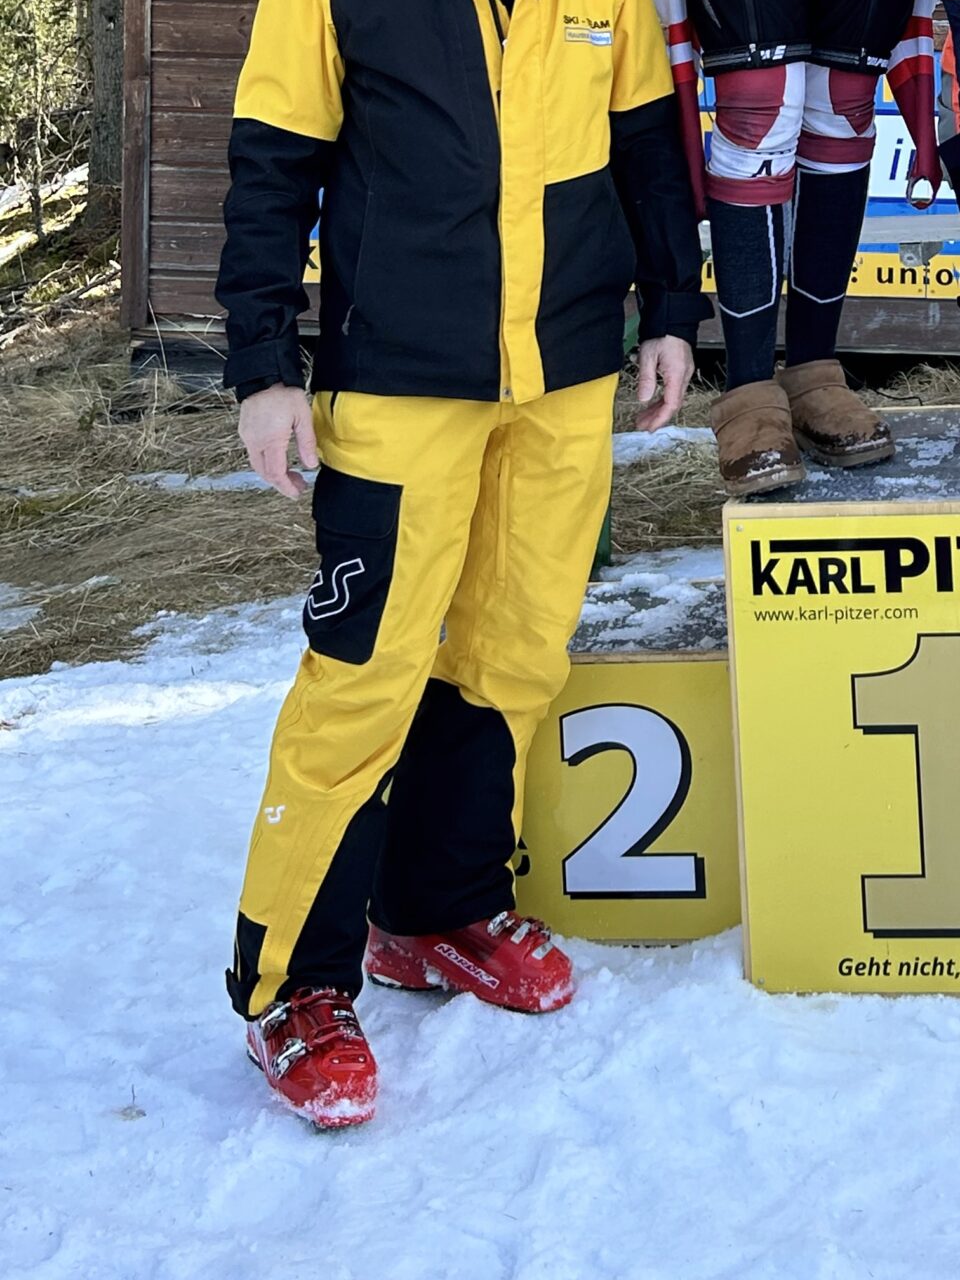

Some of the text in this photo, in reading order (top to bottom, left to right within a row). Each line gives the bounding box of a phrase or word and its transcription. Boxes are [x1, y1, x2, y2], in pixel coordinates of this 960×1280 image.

[754, 605, 919, 624] www.karl-pitzer.com
[559, 702, 706, 899] 2
[437, 945, 498, 987] NORDICA
[838, 957, 892, 977] Geht
[898, 956, 960, 980] nicht,
